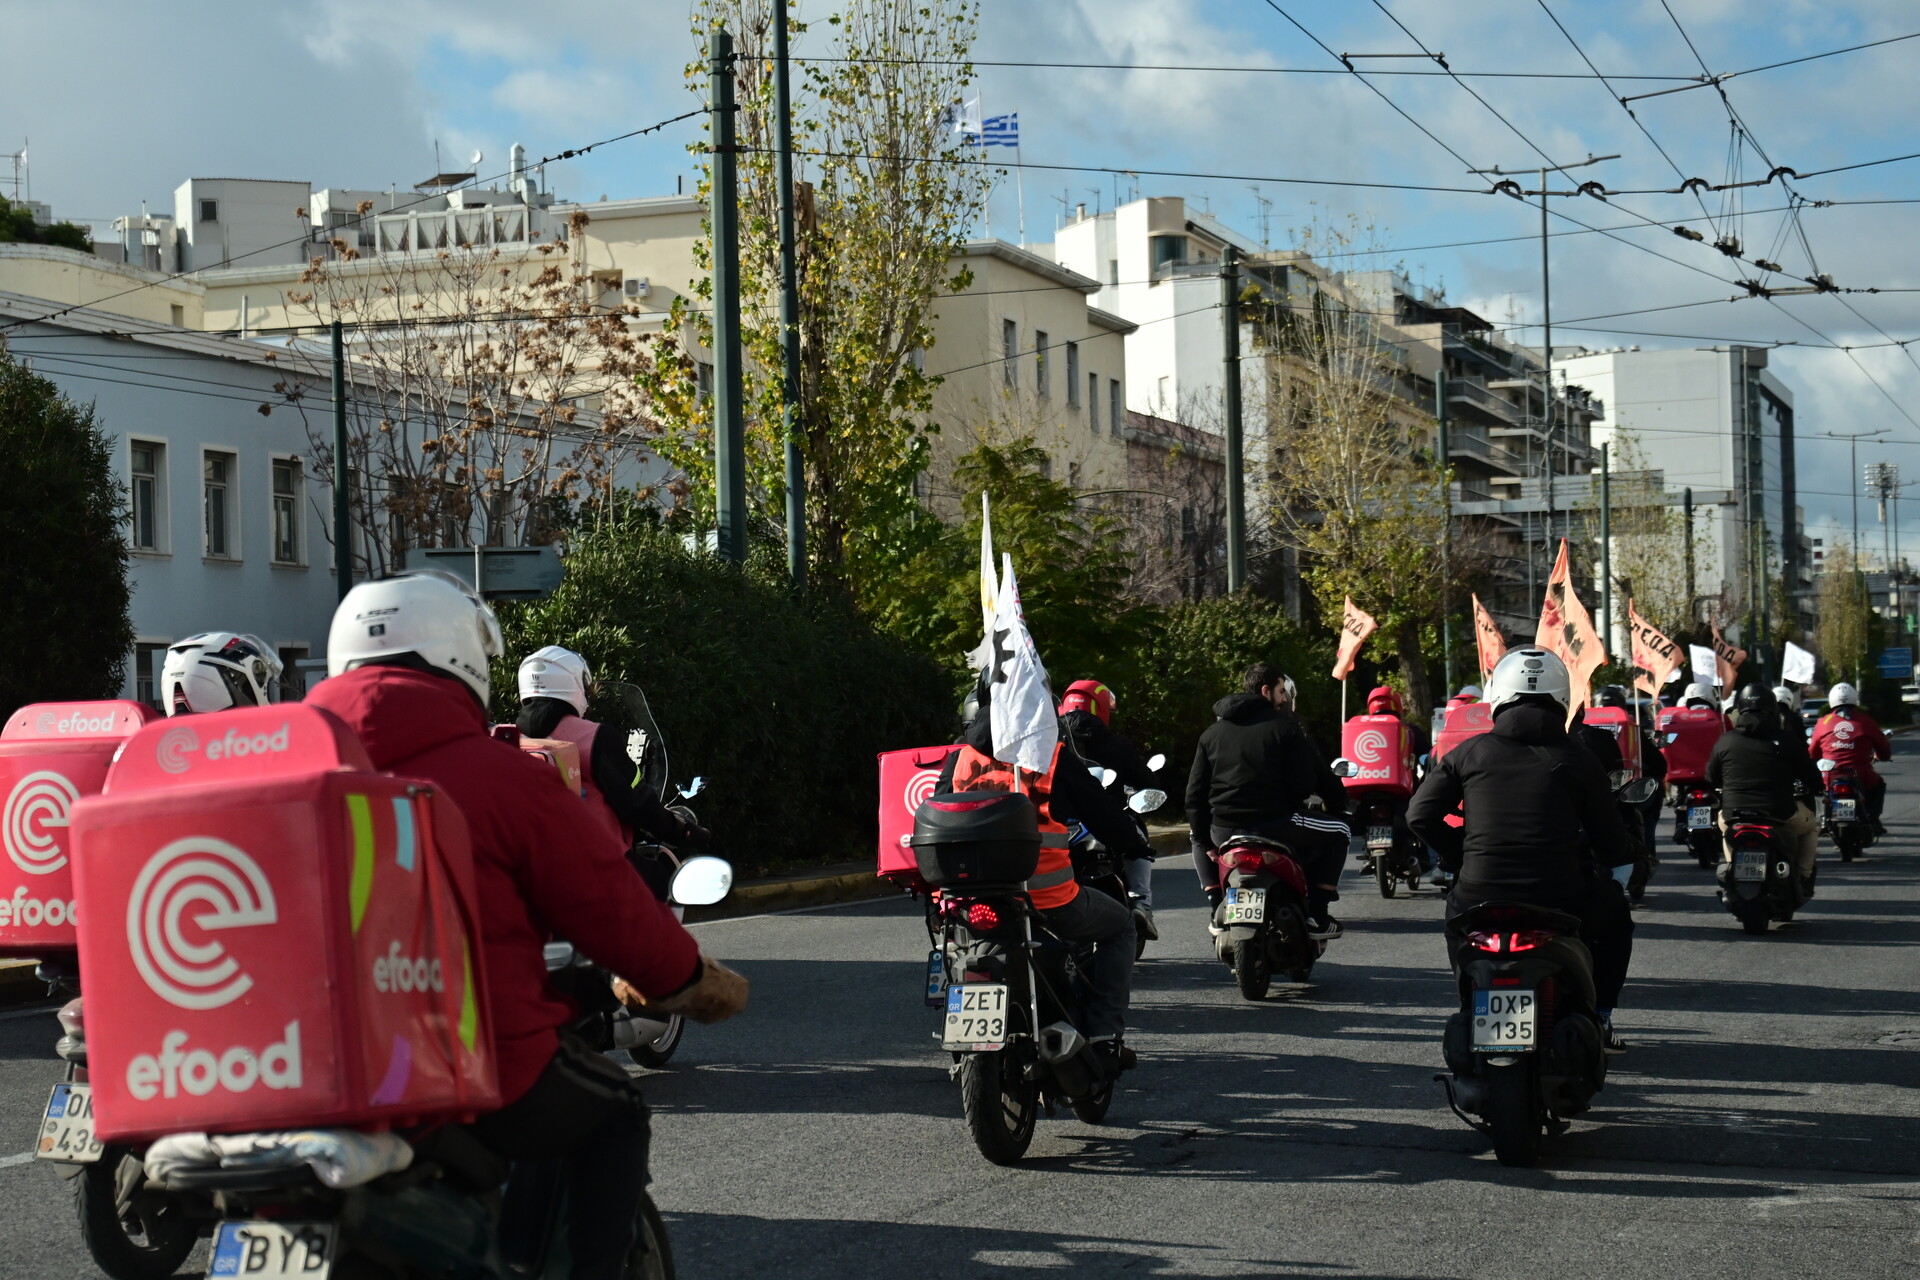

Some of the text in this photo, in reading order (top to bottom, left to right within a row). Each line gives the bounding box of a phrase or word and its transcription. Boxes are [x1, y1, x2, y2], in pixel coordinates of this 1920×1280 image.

[57, 711, 116, 733] efood
[205, 722, 289, 760] efood
[1235, 907, 1262, 920] 509
[963, 990, 1005, 1011] ZET
[1490, 995, 1532, 1015] OXP
[962, 1018, 1004, 1037] 733
[1491, 1021, 1532, 1040] 135
[126, 1018, 302, 1101] efood
[244, 1233, 327, 1274] BYB
[214, 1257, 236, 1273] GR
